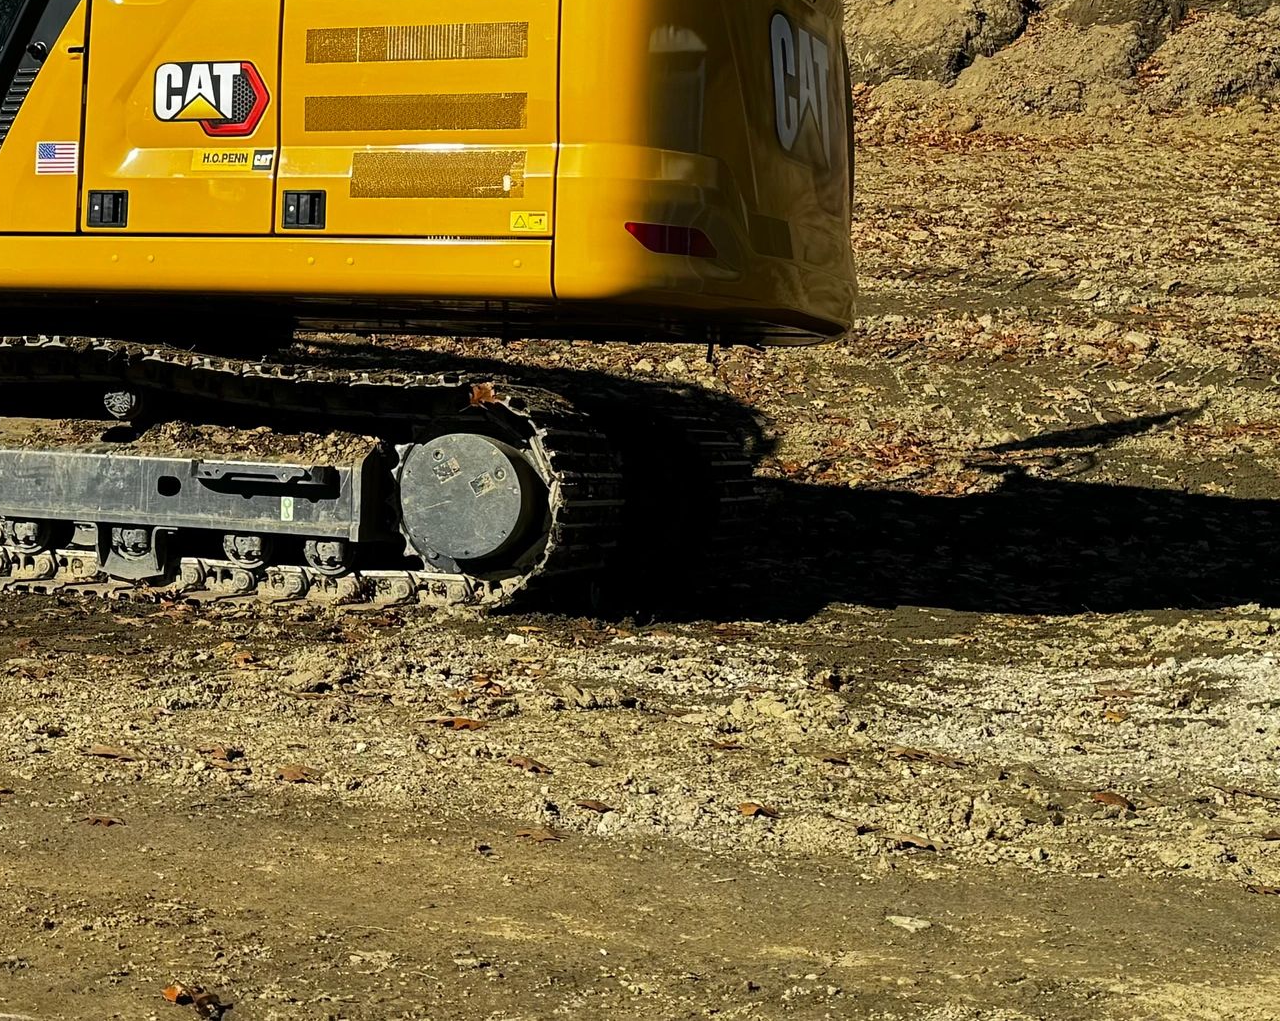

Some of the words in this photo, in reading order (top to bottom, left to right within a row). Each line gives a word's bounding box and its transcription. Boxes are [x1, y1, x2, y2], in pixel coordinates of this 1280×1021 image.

[155, 62, 241, 119] CAT
[770, 13, 831, 169] CAT
[202, 153, 248, 164] H.O.PENN
